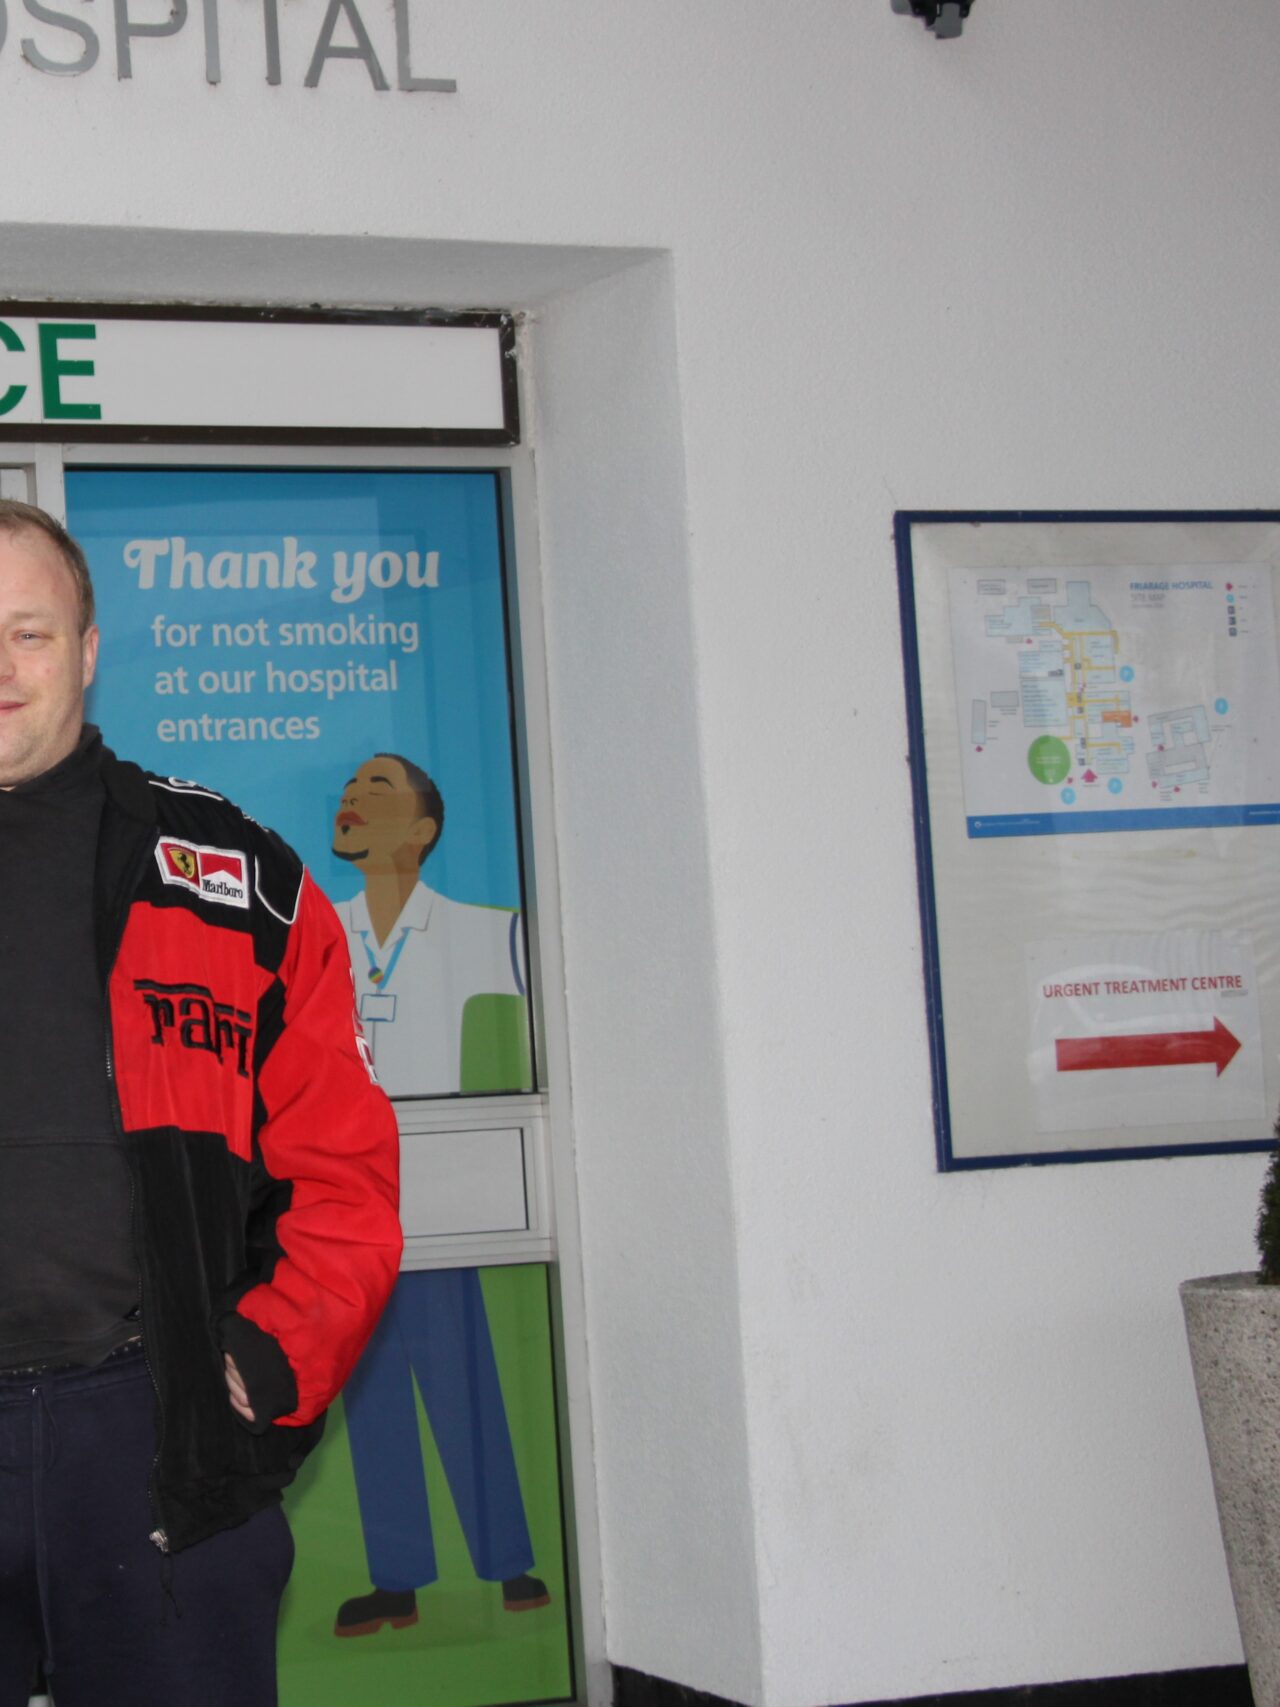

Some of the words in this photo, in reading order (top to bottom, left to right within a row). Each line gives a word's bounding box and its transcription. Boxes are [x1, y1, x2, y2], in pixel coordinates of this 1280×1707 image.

[123, 537, 318, 589] Thank
[331, 551, 440, 603] you
[1171, 580, 1213, 590] HOSPITAL
[151, 614, 202, 648] for
[213, 618, 270, 646] not
[278, 613, 420, 653] smoking
[154, 667, 189, 695] at
[198, 670, 256, 695] our
[266, 659, 398, 700] hospital
[156, 713, 320, 742] entrances
[201, 878, 244, 899] Marlboro
[1043, 981, 1100, 998] URGENT
[1104, 978, 1188, 995] TREATMENT
[1191, 975, 1242, 991] CENTRE
